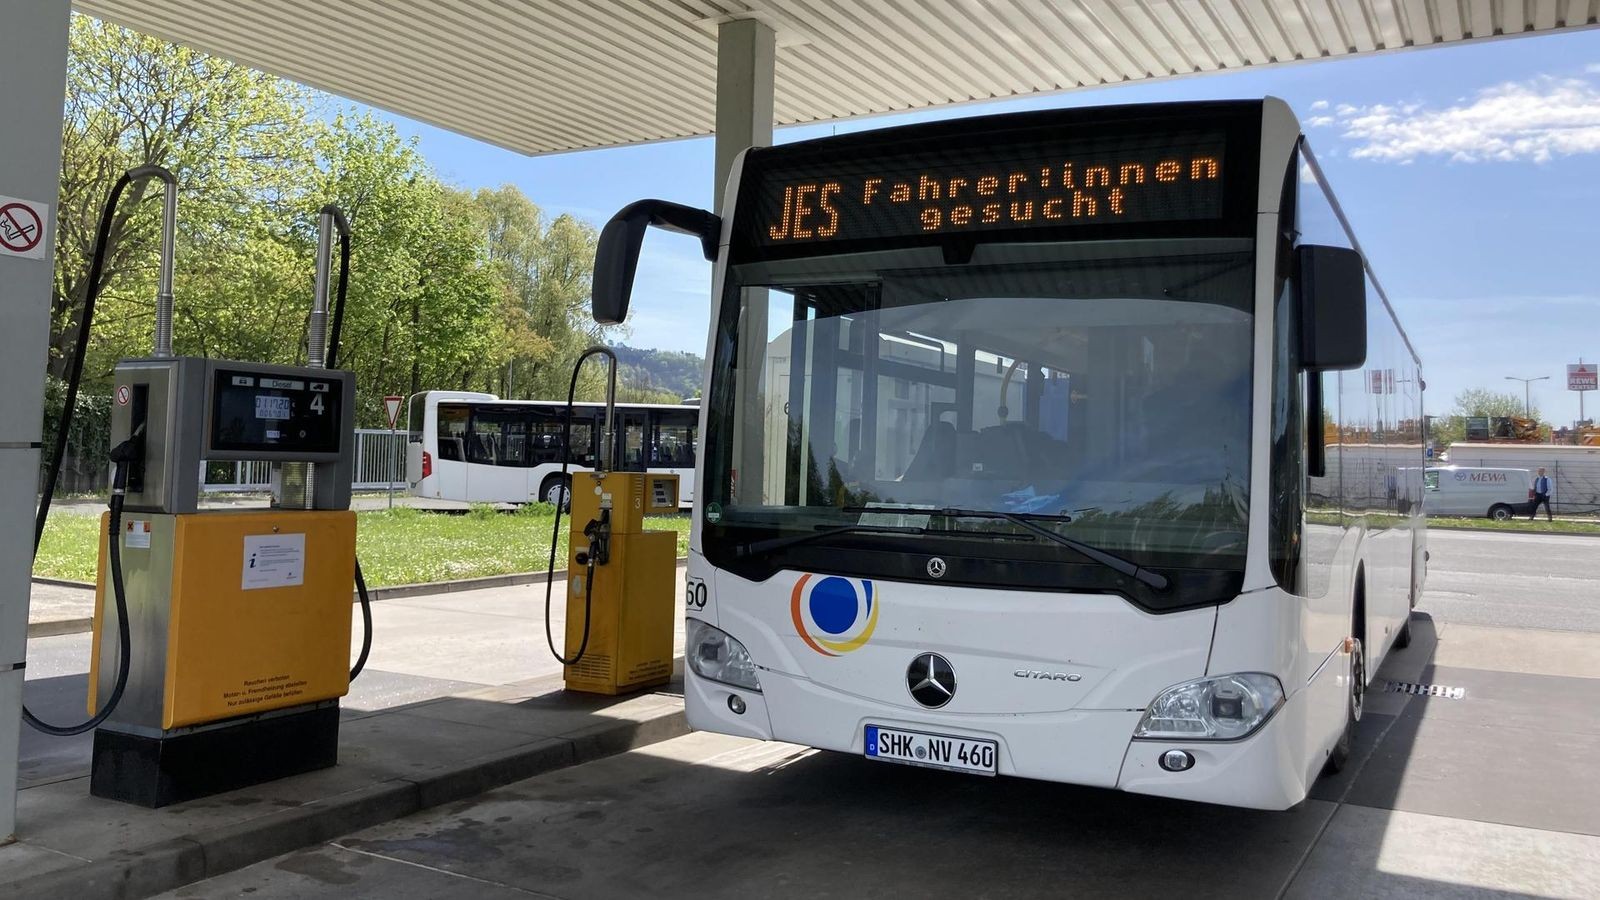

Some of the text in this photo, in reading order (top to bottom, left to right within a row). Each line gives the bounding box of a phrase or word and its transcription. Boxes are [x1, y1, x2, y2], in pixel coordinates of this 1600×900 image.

[863, 158, 1218, 205] Fahrer:innen
[769, 182, 841, 240] JES
[920, 187, 1124, 231] gesucht
[272, 380, 292, 388] Diesel
[1570, 377, 1596, 385] REWE
[310, 393, 325, 416] 4
[1470, 472, 1508, 482] MEWA
[634, 497, 641, 509] 3
[686, 581, 708, 609] 60
[268, 674, 290, 682] verboten
[1014, 665, 1082, 682] CITARO
[879, 732, 993, 768] SHK NV 460
